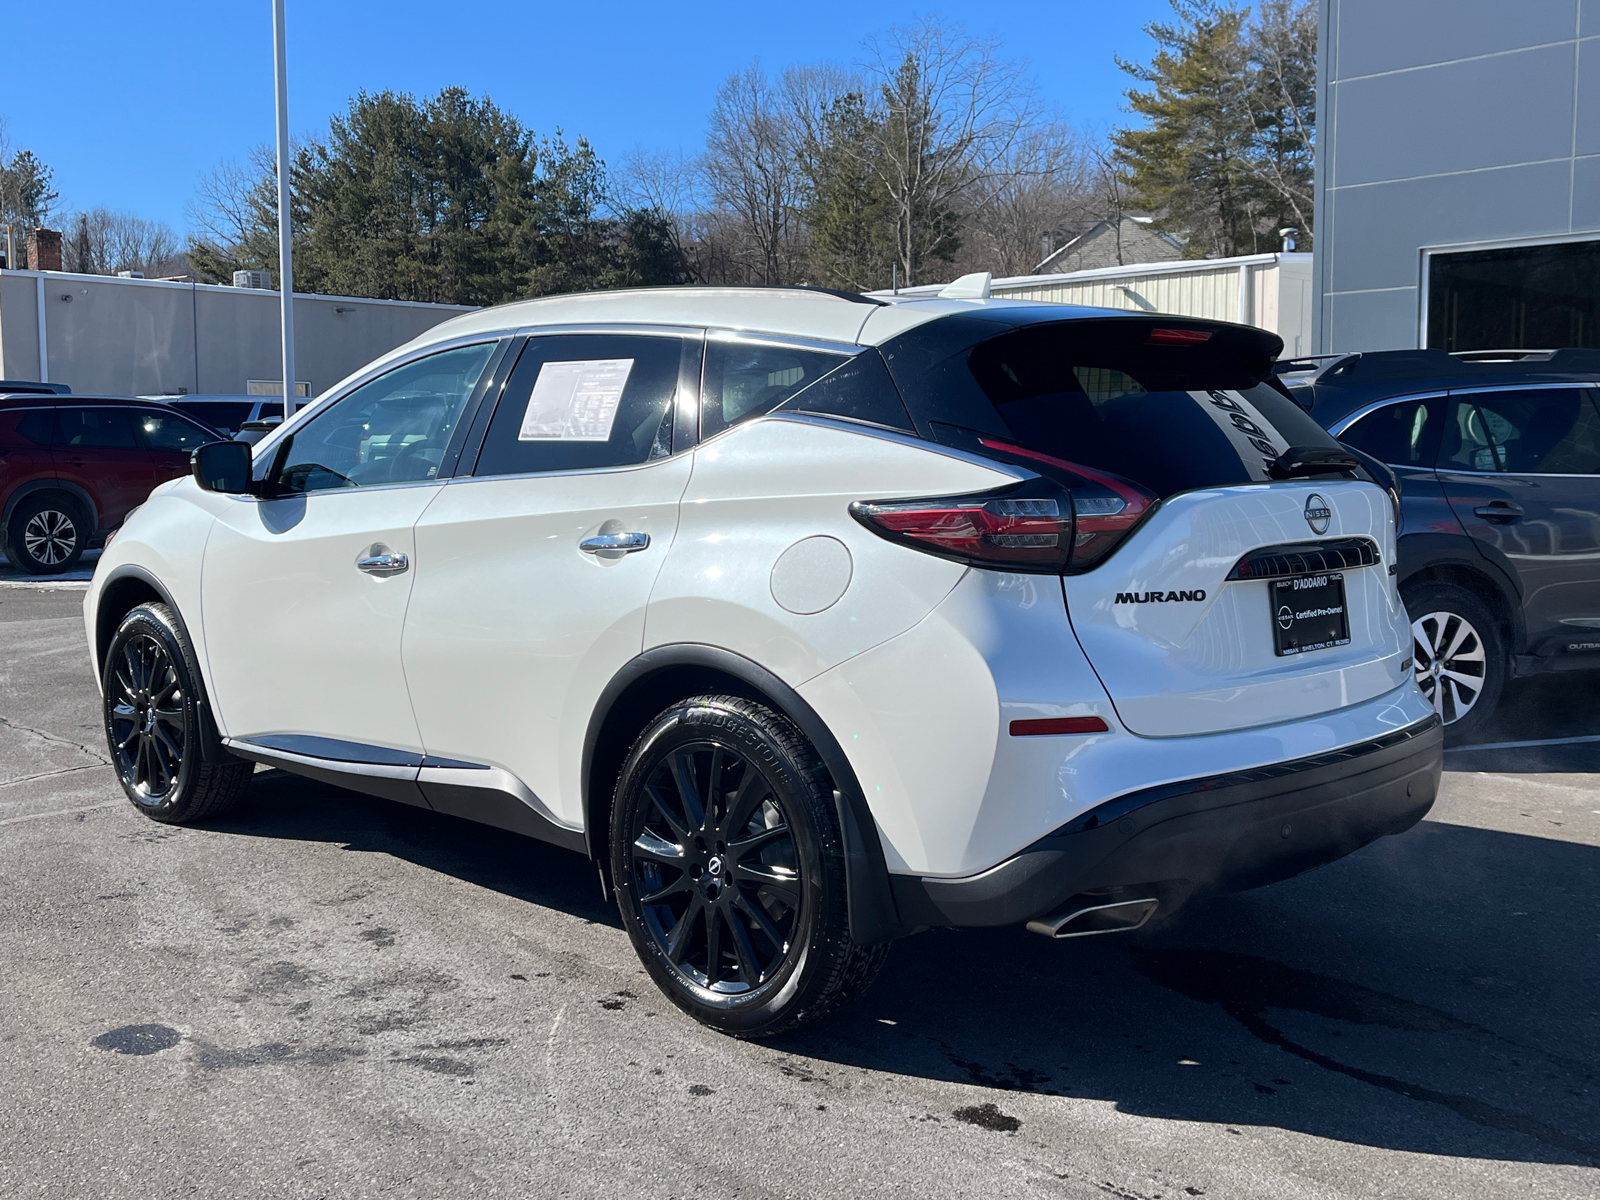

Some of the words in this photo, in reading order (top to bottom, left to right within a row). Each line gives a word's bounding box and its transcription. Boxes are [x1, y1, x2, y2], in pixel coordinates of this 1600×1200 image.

[1293, 576, 1328, 590] D'ADDARIO
[1114, 589, 1207, 604] MURANO
[1296, 610, 1317, 619] Certified
[1318, 606, 1342, 615] Pre-Owned
